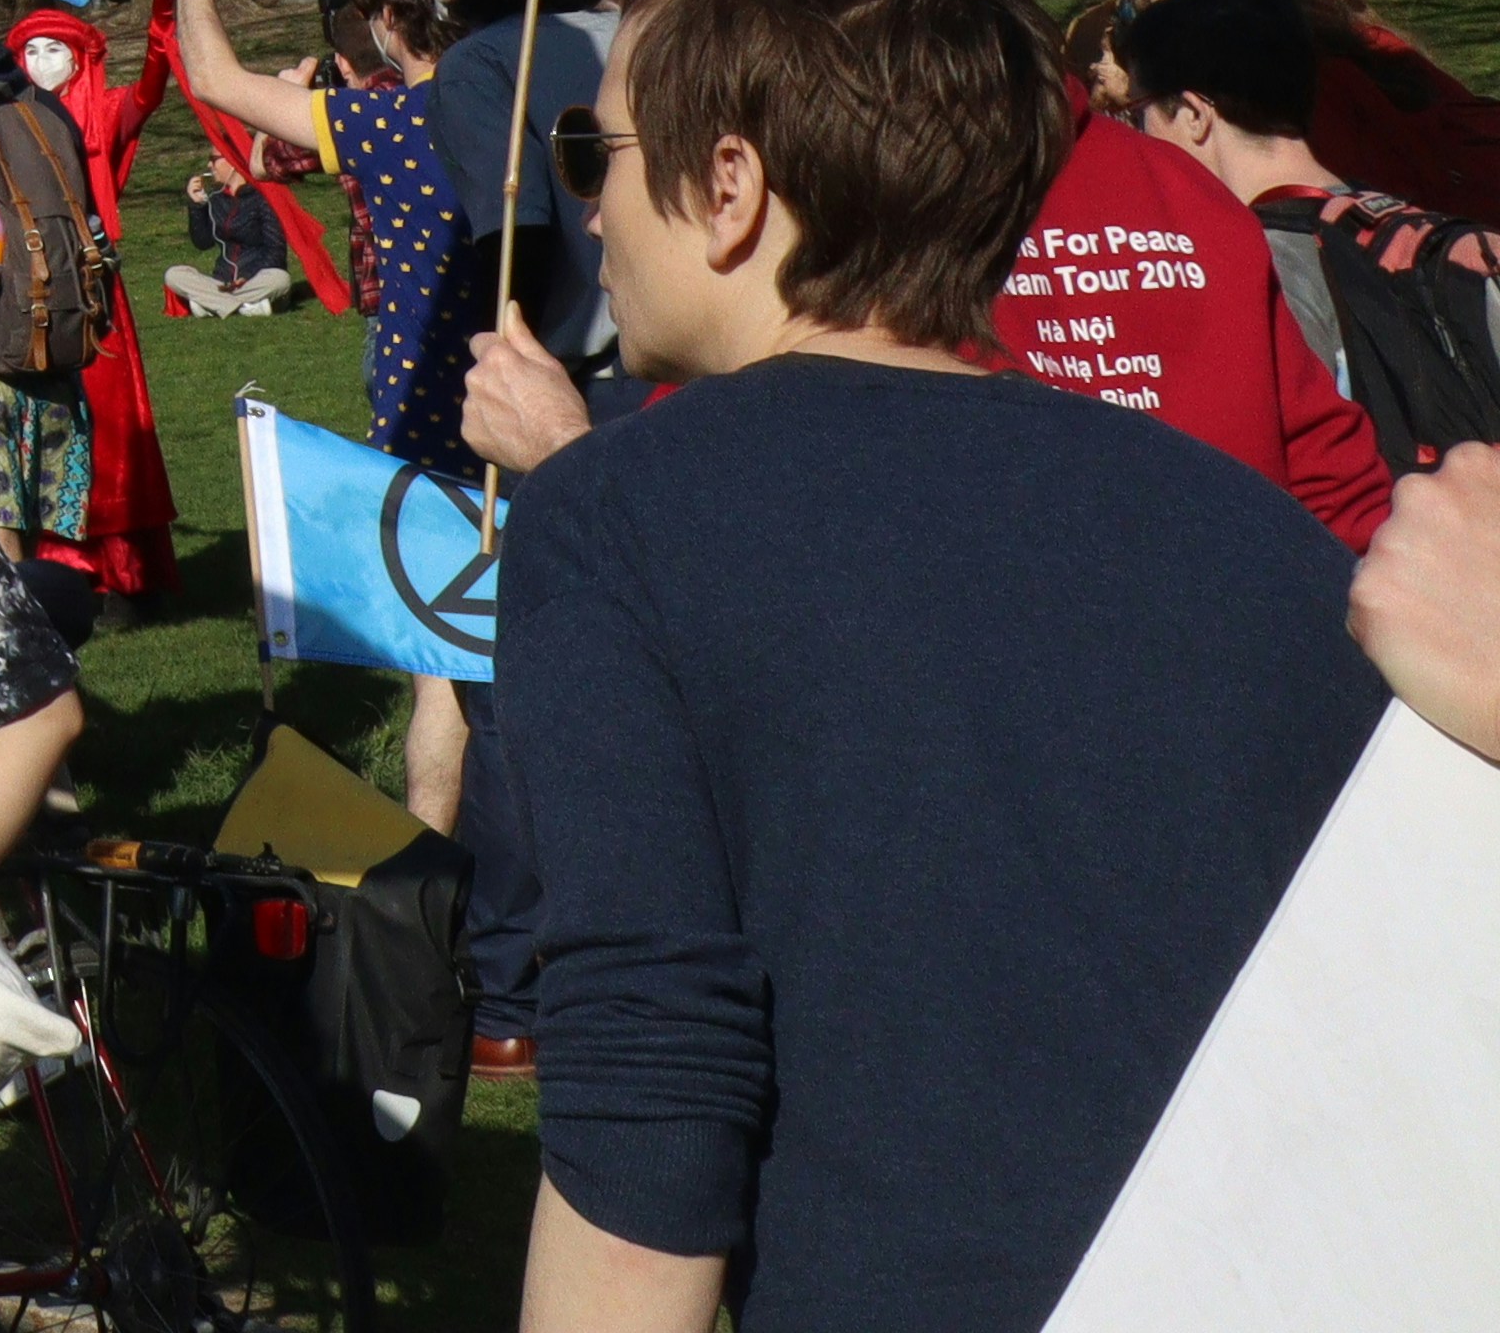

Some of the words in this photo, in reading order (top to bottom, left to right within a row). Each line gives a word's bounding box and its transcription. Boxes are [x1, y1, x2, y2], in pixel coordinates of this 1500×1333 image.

[1042, 228, 1100, 259] For
[1104, 225, 1195, 255] Peace
[1053, 265, 1130, 296] Tour
[1136, 260, 1207, 290] 2019
[1036, 318, 1067, 343] Hà
[1068, 315, 1116, 346] Nội
[1061, 354, 1094, 383] Hạ
[1096, 352, 1163, 379] Long
